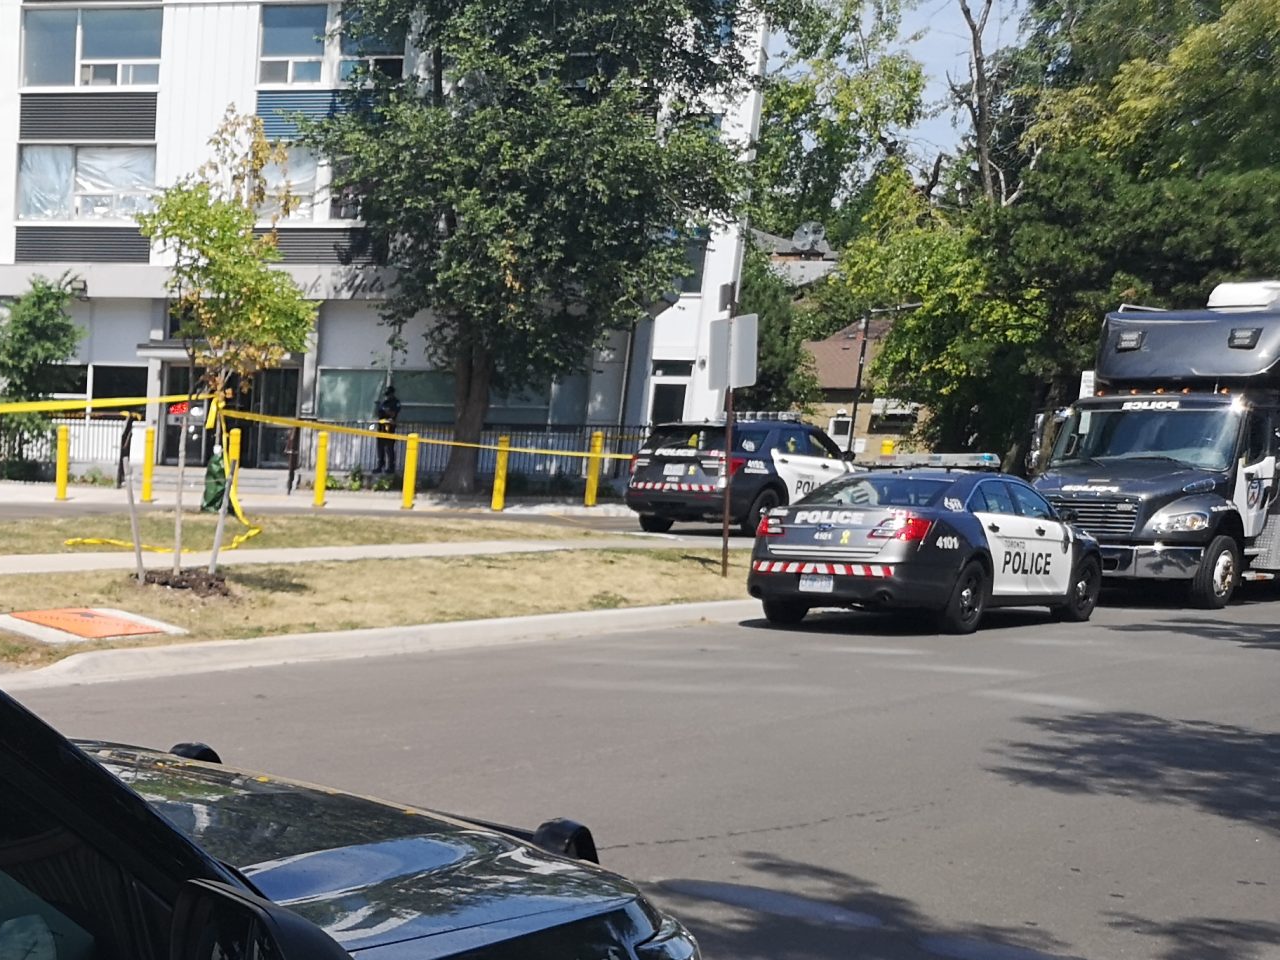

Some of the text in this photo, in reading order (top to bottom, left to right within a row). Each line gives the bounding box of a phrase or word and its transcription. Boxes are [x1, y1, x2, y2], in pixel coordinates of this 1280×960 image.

[654, 448, 698, 457] POLICE
[794, 510, 865, 525] POLICE
[935, 536, 960, 549] 4101
[1002, 551, 1052, 575] POLICE
